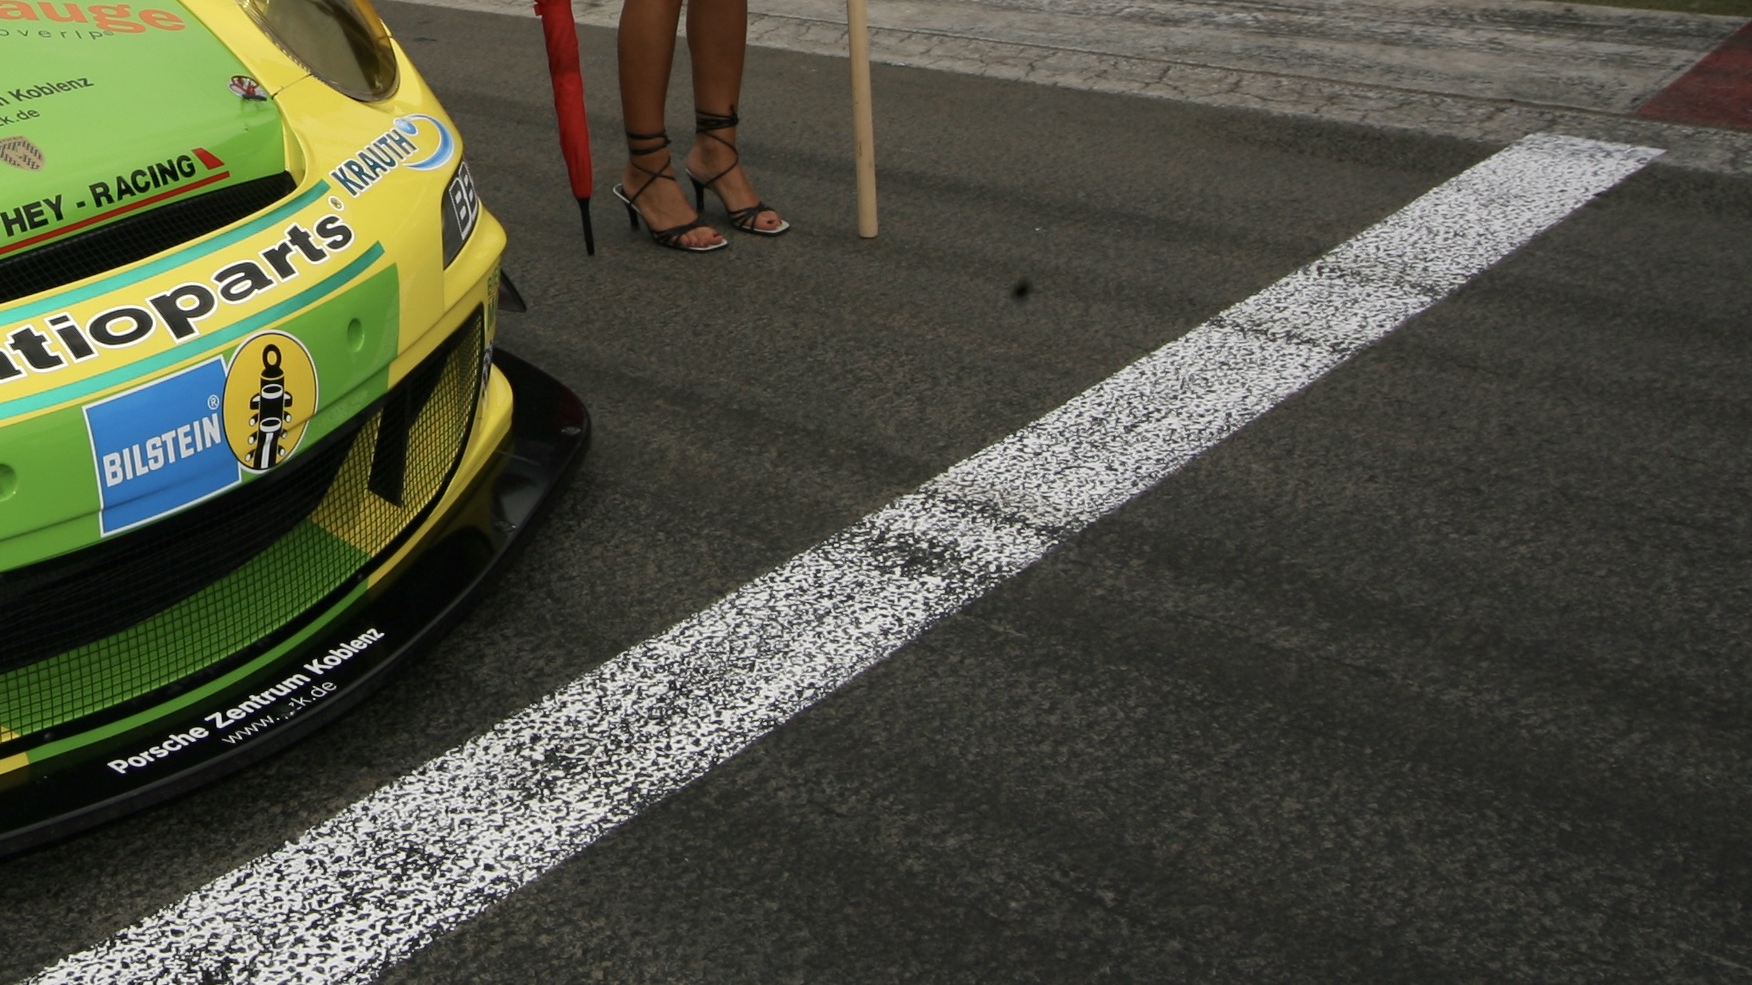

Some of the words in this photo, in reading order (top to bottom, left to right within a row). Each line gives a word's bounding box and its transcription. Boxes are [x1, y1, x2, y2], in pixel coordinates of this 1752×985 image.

[8, 77, 95, 102] Koblenz
[88, 154, 196, 209] RACING
[331, 129, 417, 196] KRAUTH
[449, 162, 478, 240] BB
[102, 413, 221, 487] BILSTEIN
[107, 725, 210, 774] Porsche
[204, 673, 311, 729] Zentrum
[304, 627, 385, 675] Koblenz
